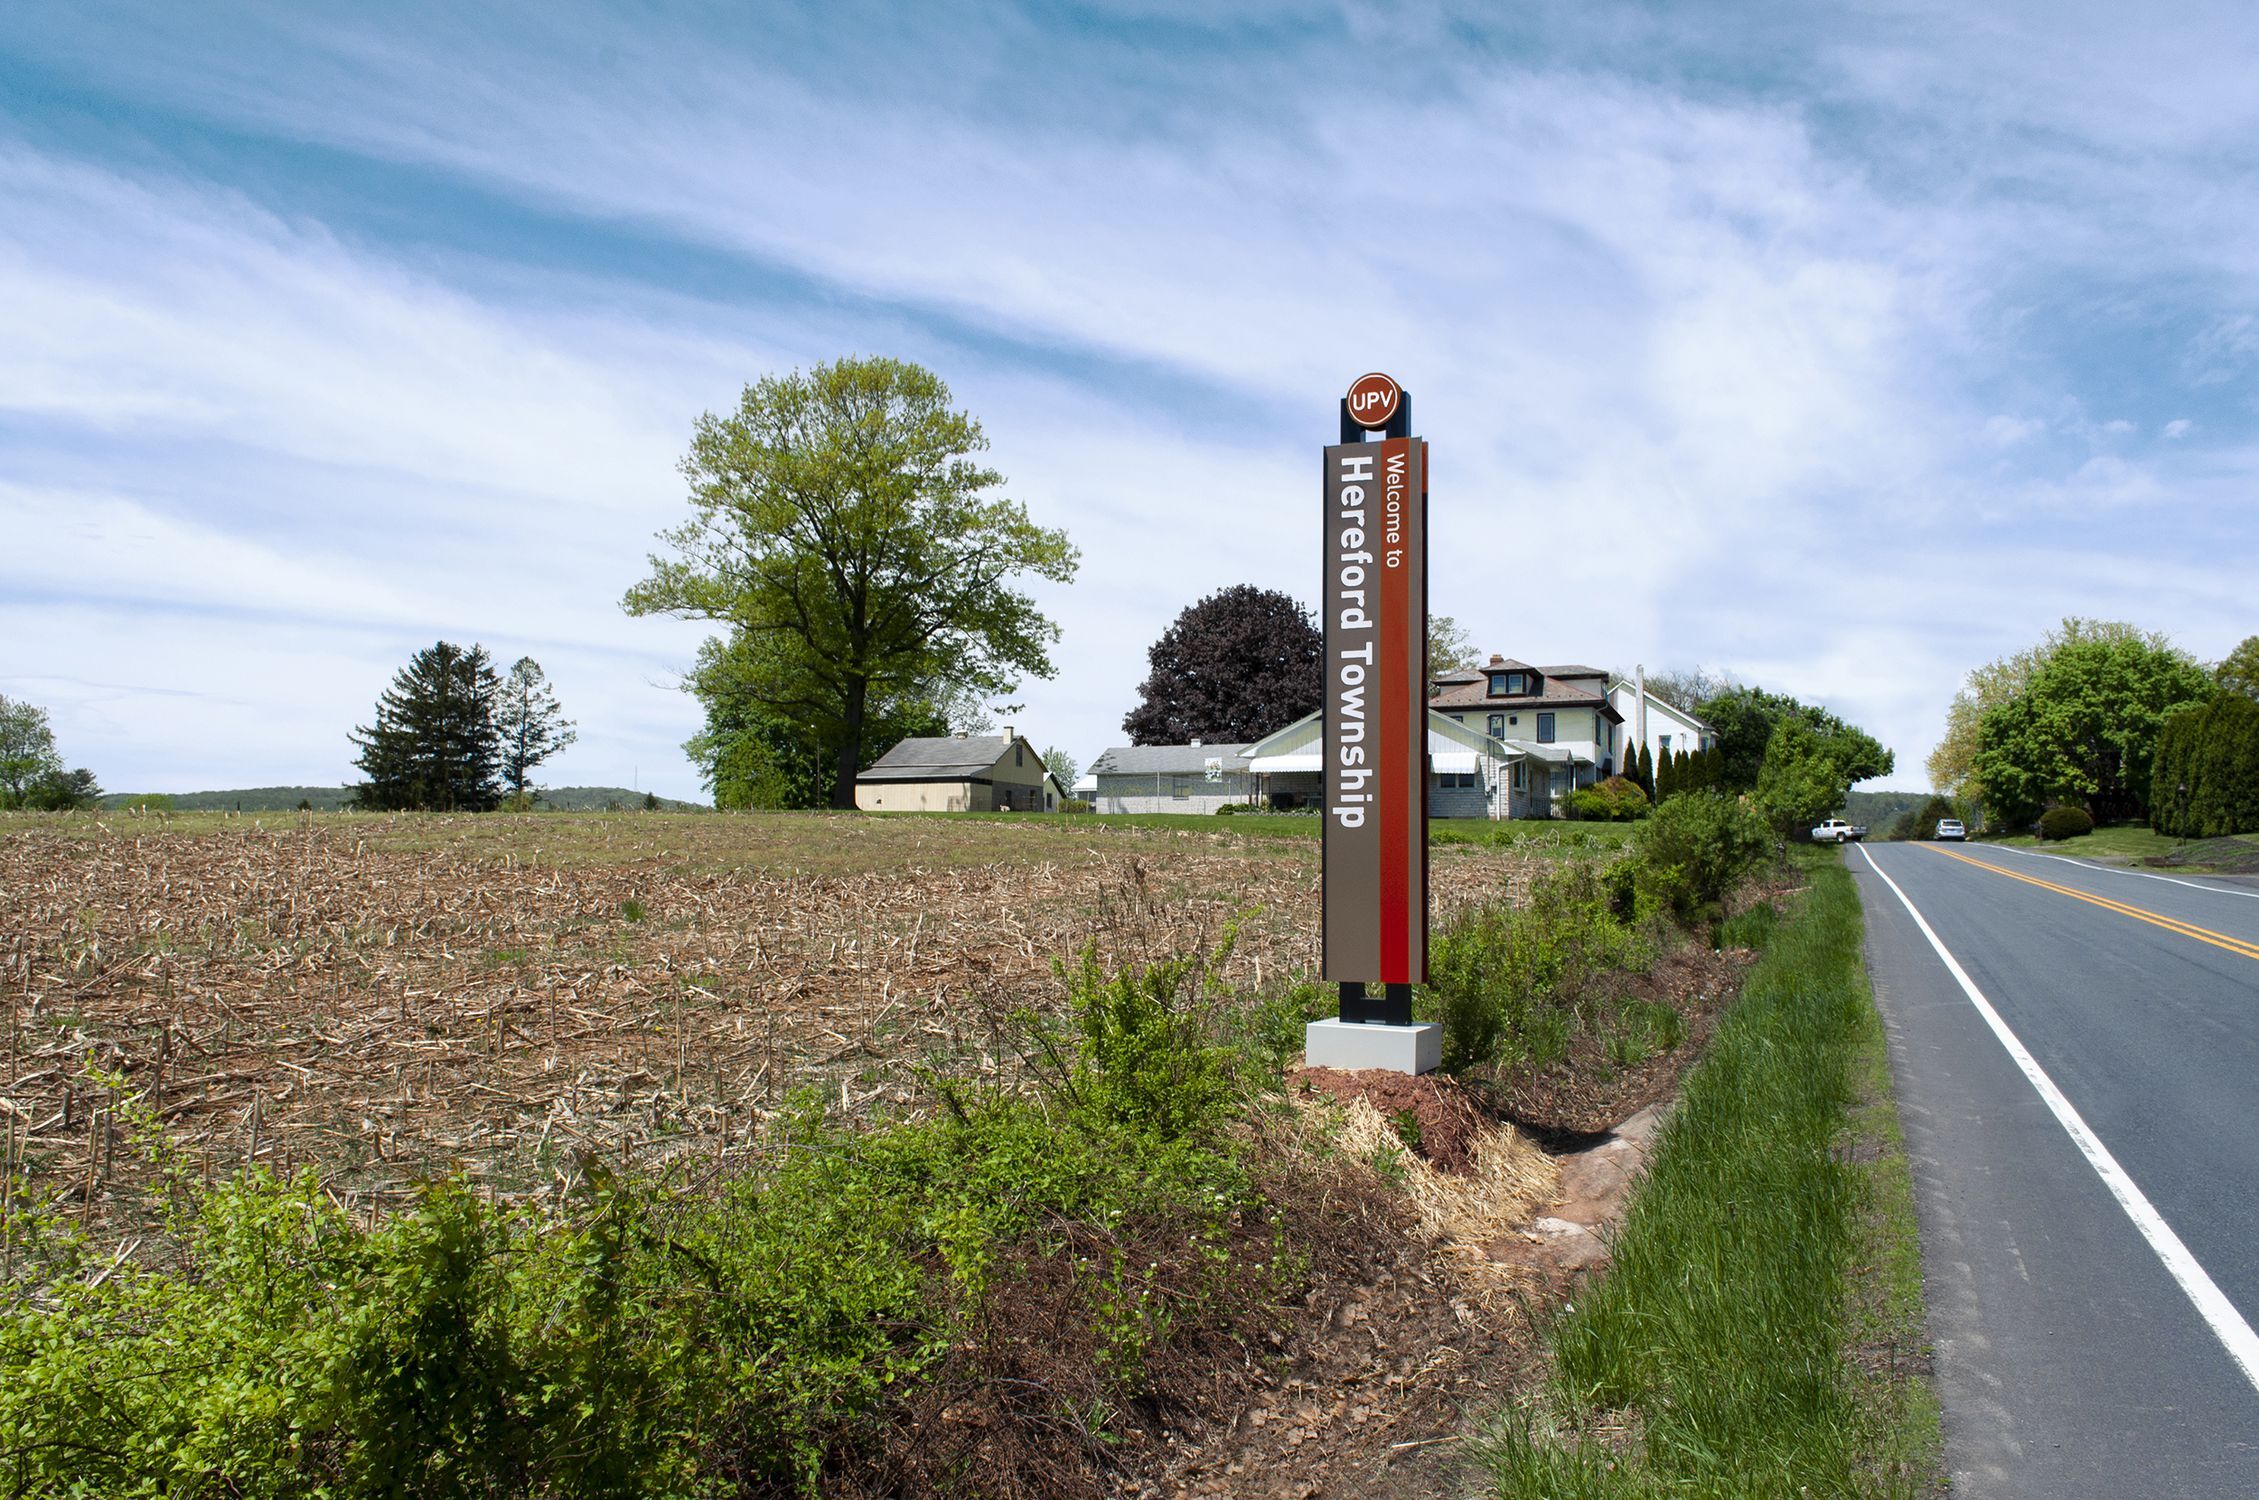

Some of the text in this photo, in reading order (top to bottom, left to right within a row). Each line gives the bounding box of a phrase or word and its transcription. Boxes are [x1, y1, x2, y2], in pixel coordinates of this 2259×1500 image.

[1353, 389, 1394, 411] UPV
[1386, 453, 1405, 569] Welcome to
[1332, 456, 1373, 828] Hereford Township
